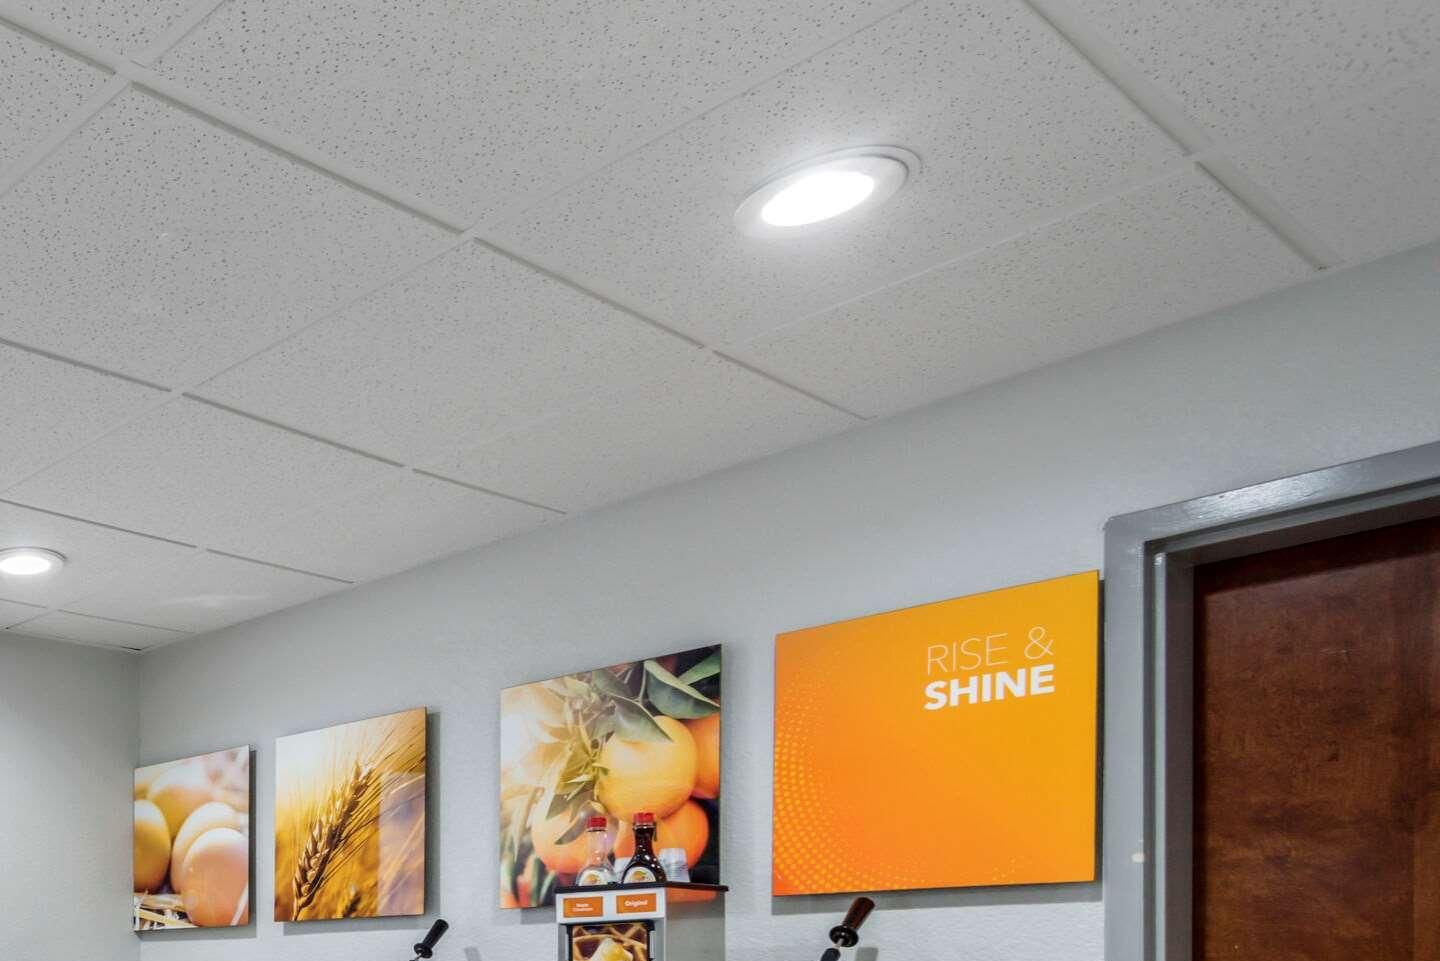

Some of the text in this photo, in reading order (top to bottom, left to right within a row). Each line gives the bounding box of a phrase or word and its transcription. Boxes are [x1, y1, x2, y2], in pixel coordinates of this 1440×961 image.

[926, 625, 1055, 676] RISE &
[924, 663, 1056, 711] SHINE
